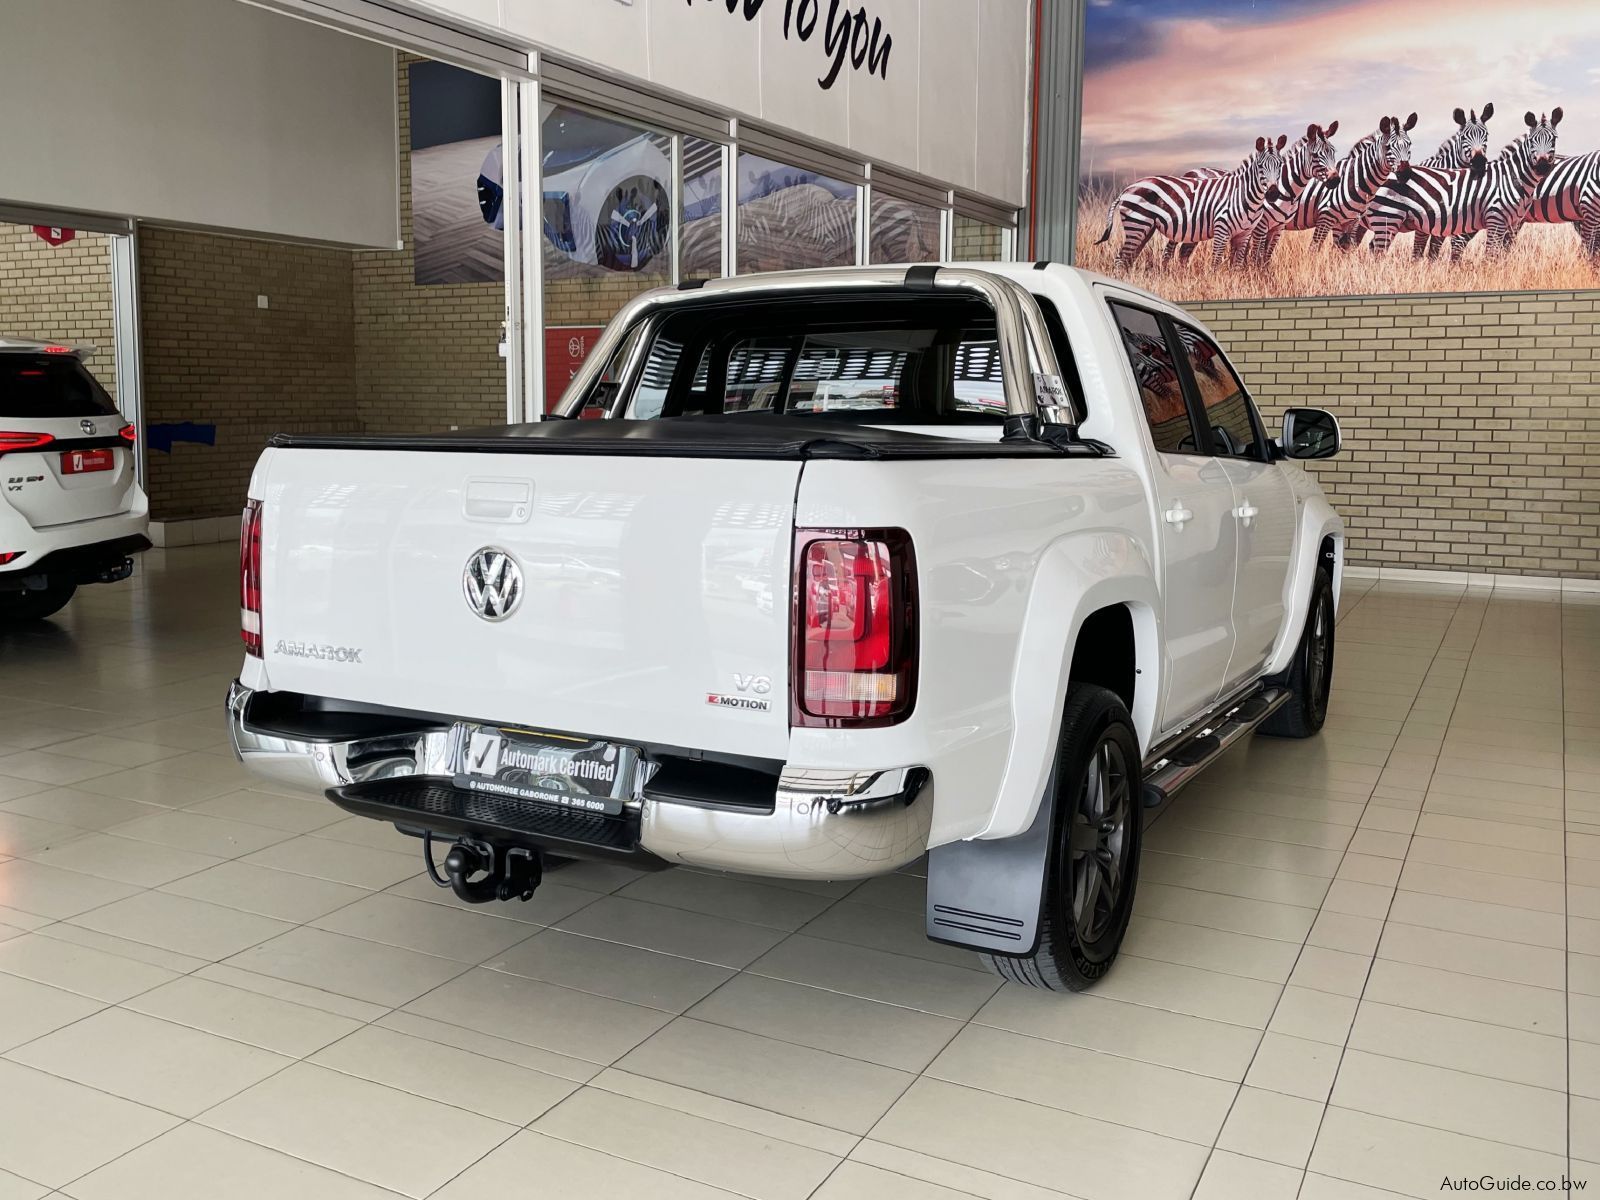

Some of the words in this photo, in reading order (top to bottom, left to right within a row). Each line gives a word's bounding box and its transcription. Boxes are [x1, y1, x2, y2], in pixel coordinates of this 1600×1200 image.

[817, 0, 893, 90] you
[273, 639, 363, 663] AMAROK
[733, 672, 772, 694] V6
[500, 748, 557, 773] Automark
[559, 757, 615, 782] Certified
[476, 781, 519, 795] AUTOHOUSE
[519, 789, 559, 803] GABORONE
[571, 797, 586, 807] 365
[586, 799, 605, 811] 6000
